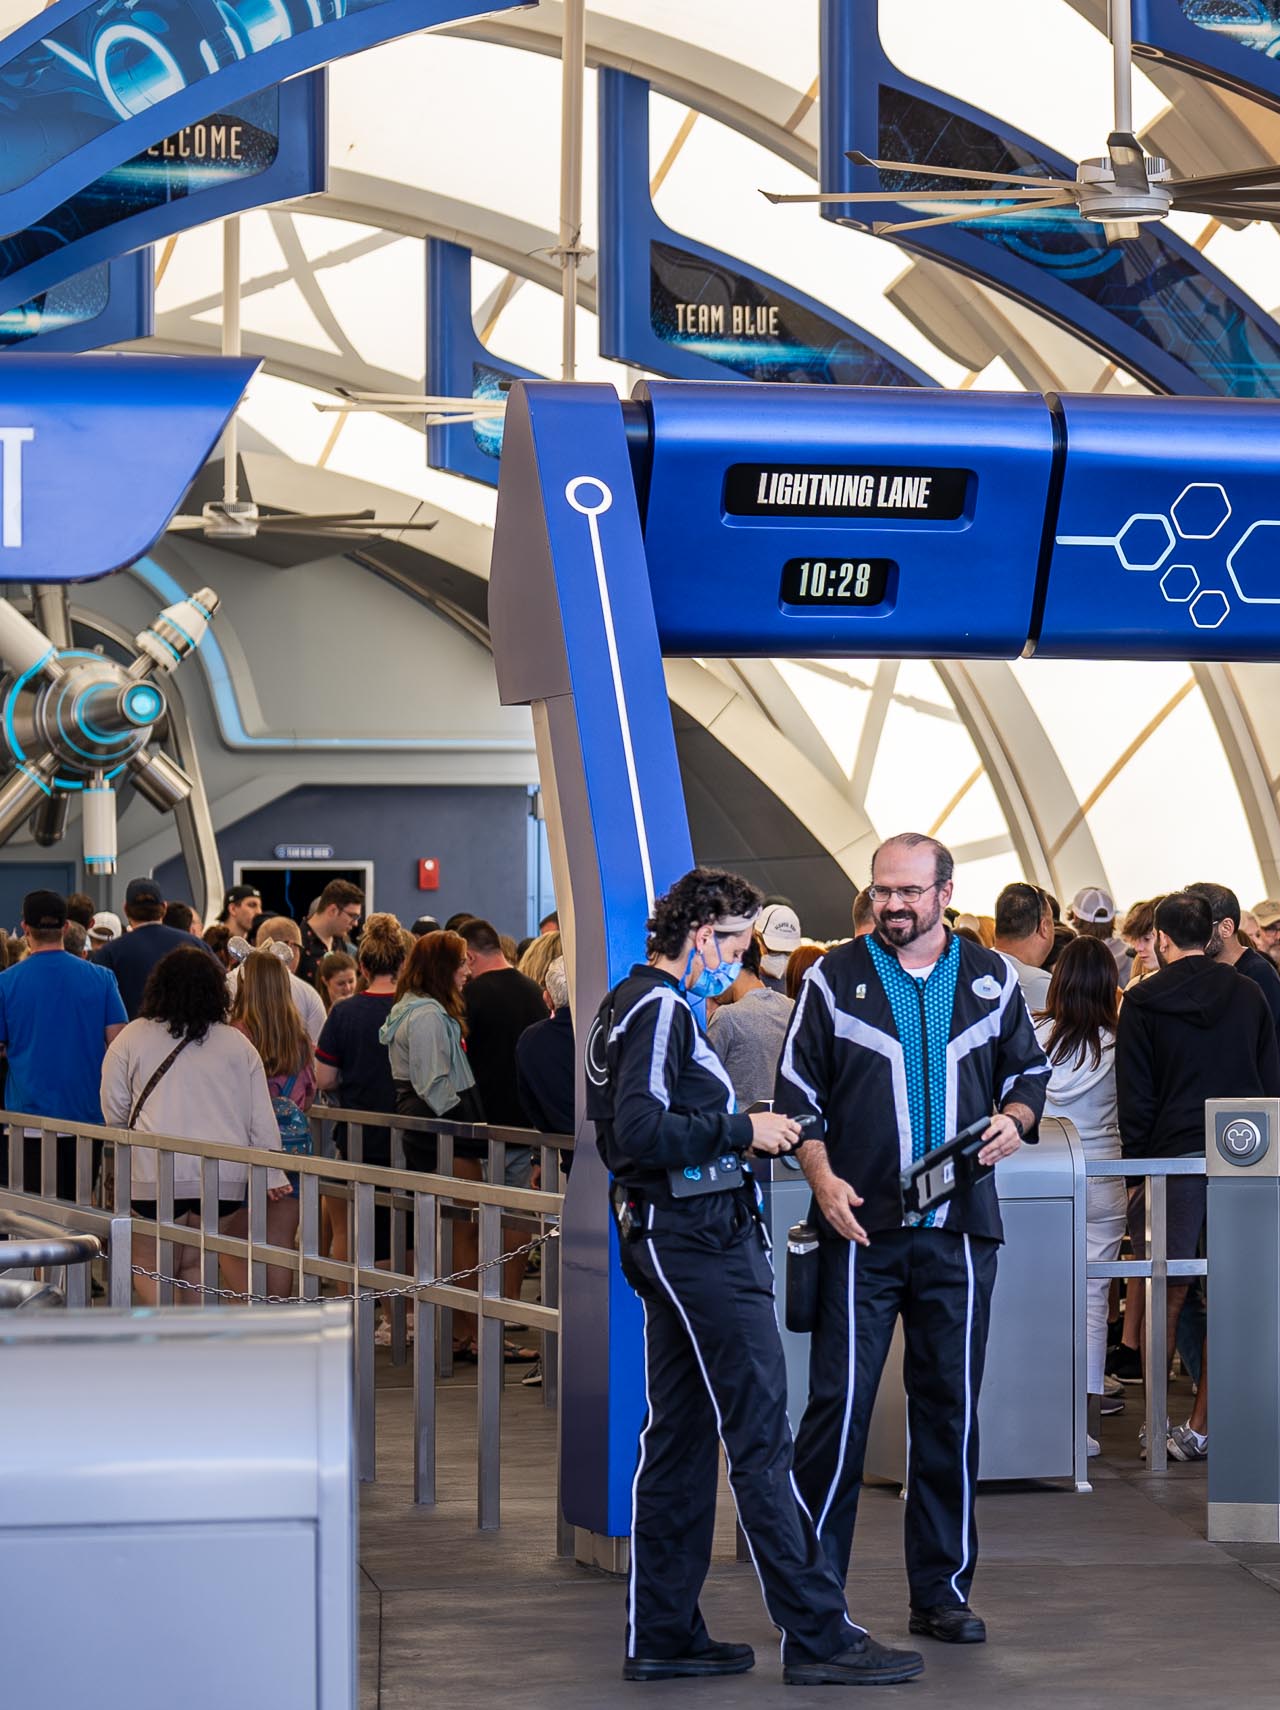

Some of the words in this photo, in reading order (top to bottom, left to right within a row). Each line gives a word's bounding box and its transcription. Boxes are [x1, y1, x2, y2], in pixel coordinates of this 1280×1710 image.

[147, 124, 242, 159] LCOME
[675, 303, 724, 334] TEAM
[732, 305, 779, 335] BLUE
[757, 472, 875, 507] LIGHTNING
[877, 476, 932, 508] LANE
[799, 562, 871, 597] 10:28
